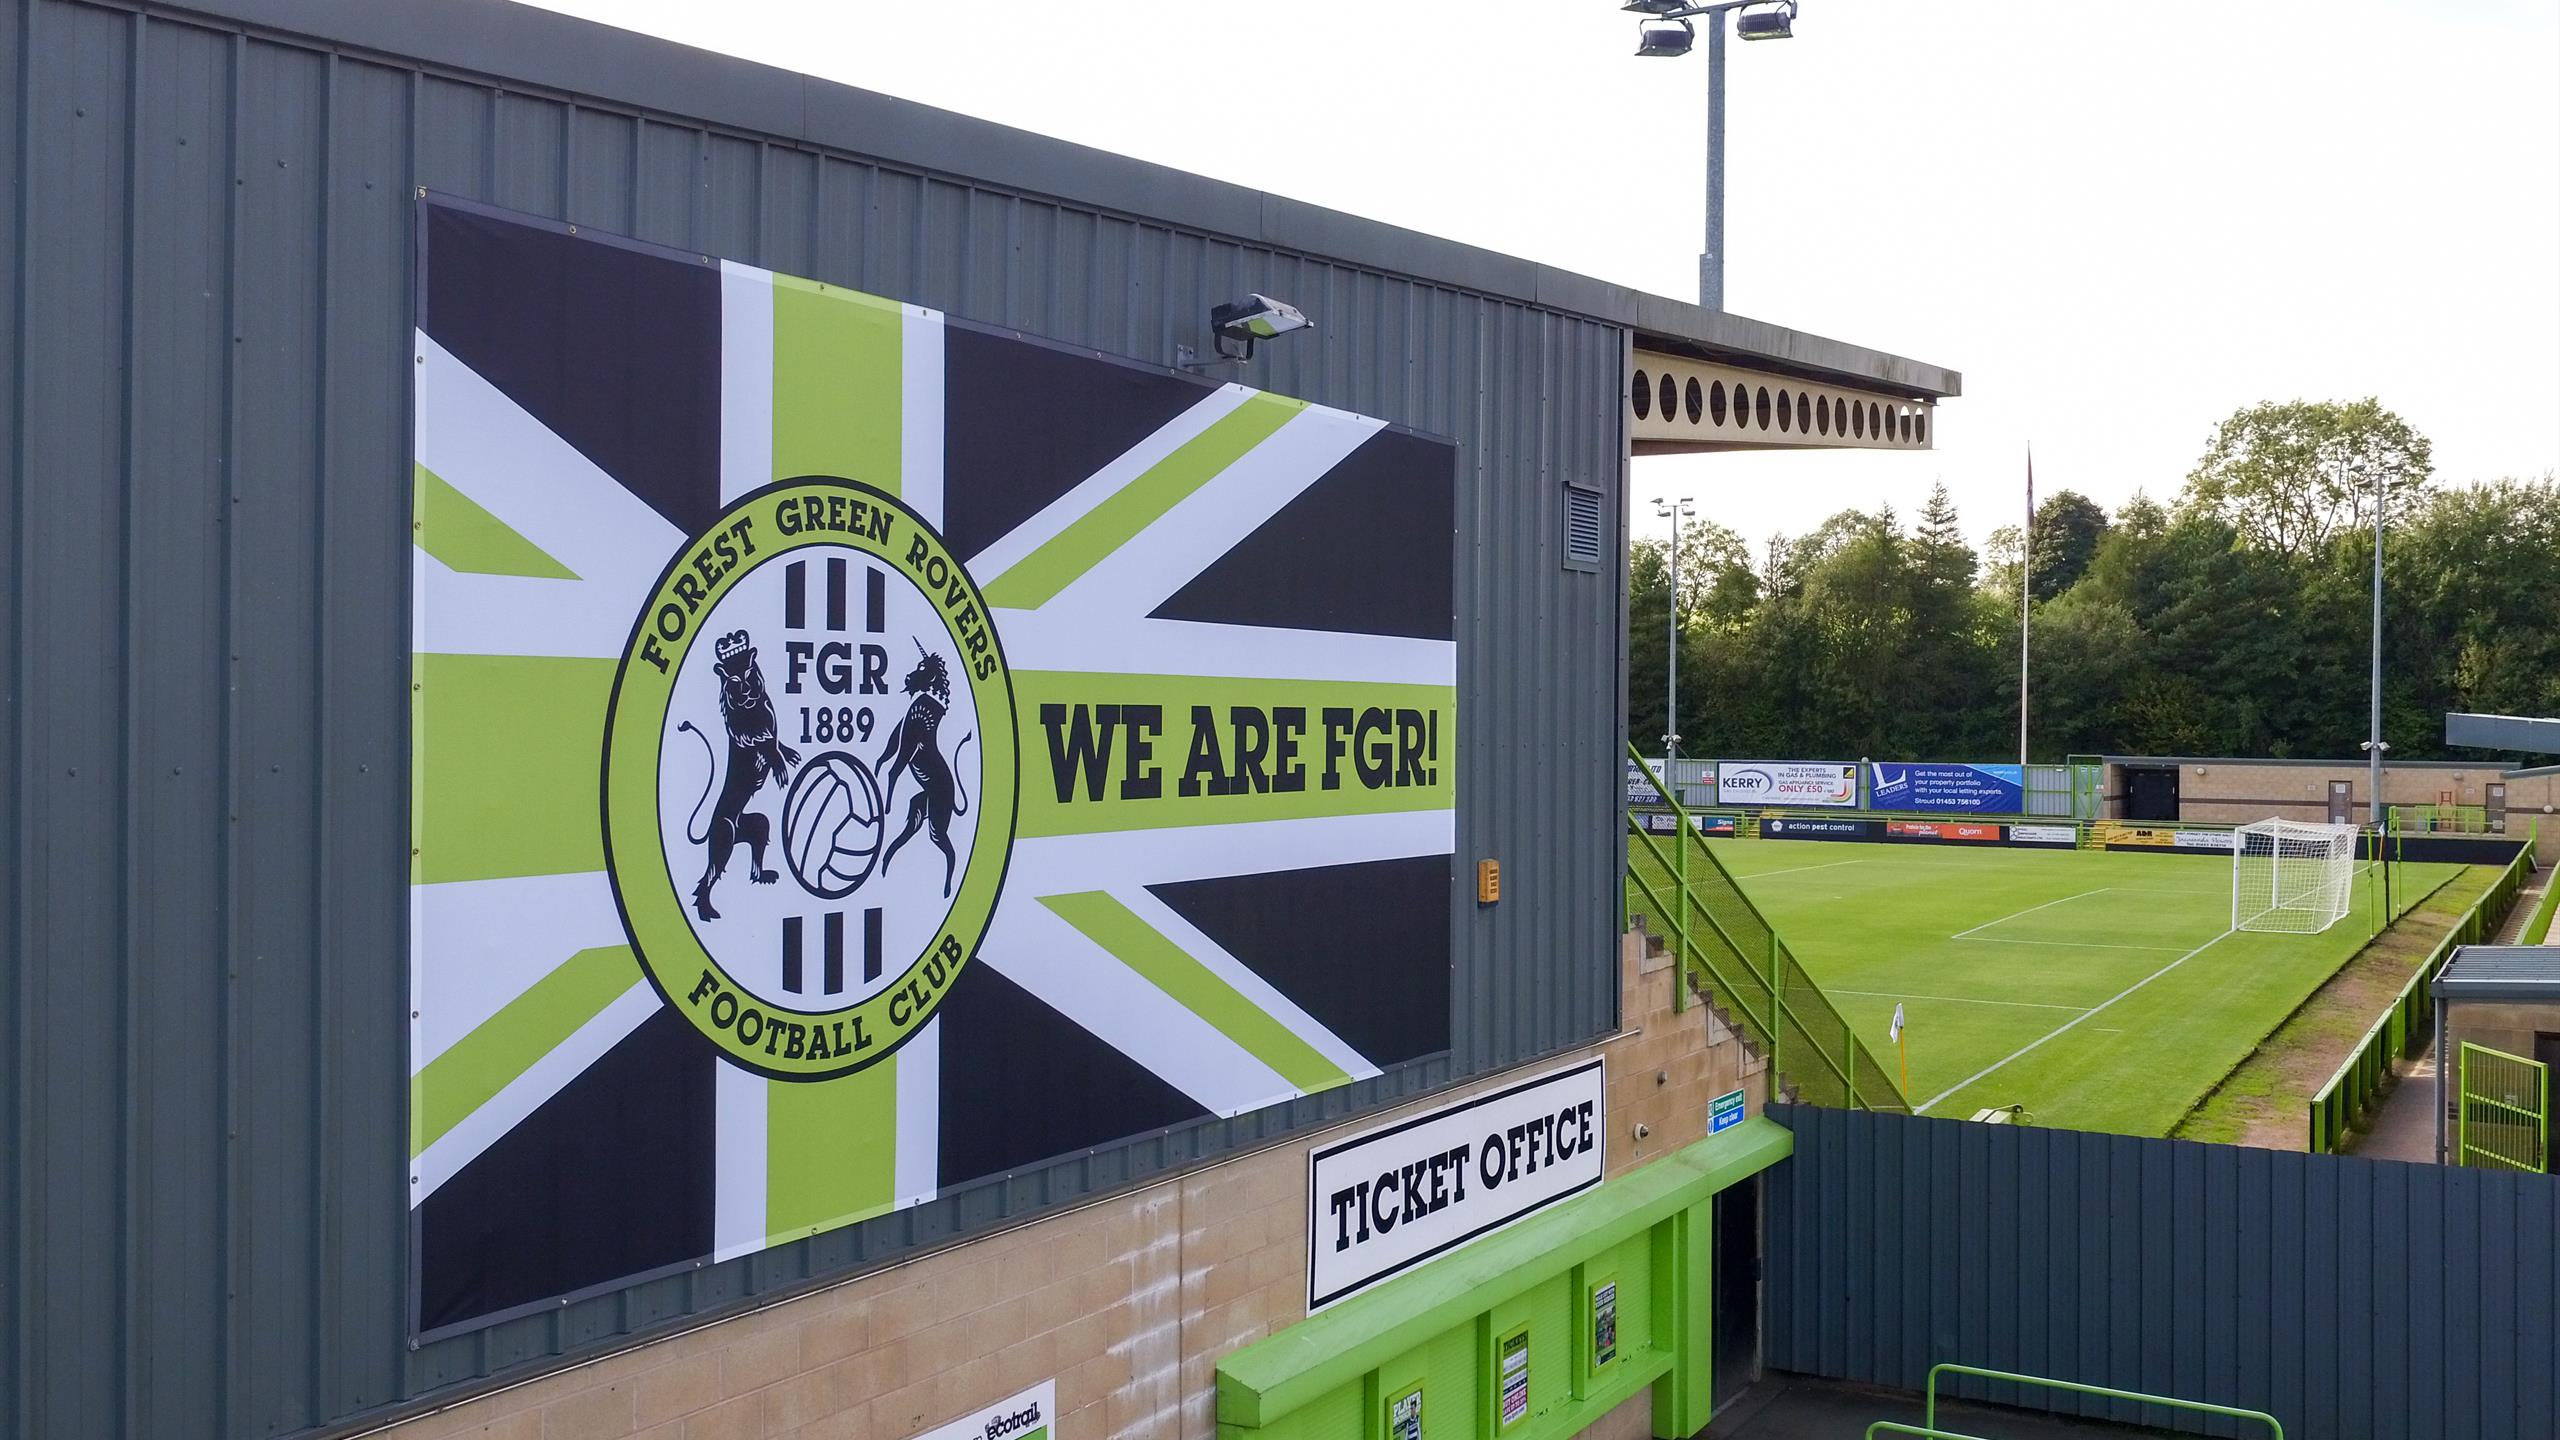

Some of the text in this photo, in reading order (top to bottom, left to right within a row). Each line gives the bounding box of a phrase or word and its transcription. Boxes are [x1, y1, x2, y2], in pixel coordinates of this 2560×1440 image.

[641, 496, 997, 682] FOREST GREEN ROVERS
[785, 642, 889, 694] FGR
[800, 707, 875, 743] 1889
[1040, 703, 1437, 803] WE ARE FGR!
[1914, 769, 1926, 777] Get
[1722, 777, 1762, 789] KERRY
[1778, 784, 1804, 793] ONLY
[1807, 785, 1823, 793] £50
[1876, 782, 1909, 798] LEADERS
[1929, 779, 1955, 787] property
[1959, 787, 1978, 795] letting
[1788, 822, 1855, 832] action pest control
[1959, 827, 1982, 836] Quorn
[688, 933, 963, 1060] FOOTBALL CLUB
[1714, 1097, 1735, 1112] Emergency
[1718, 1111, 1739, 1127] Keep clear
[1331, 1100, 1593, 1253] TICKET OFFICE
[987, 1401, 1038, 1440] ecotrail
